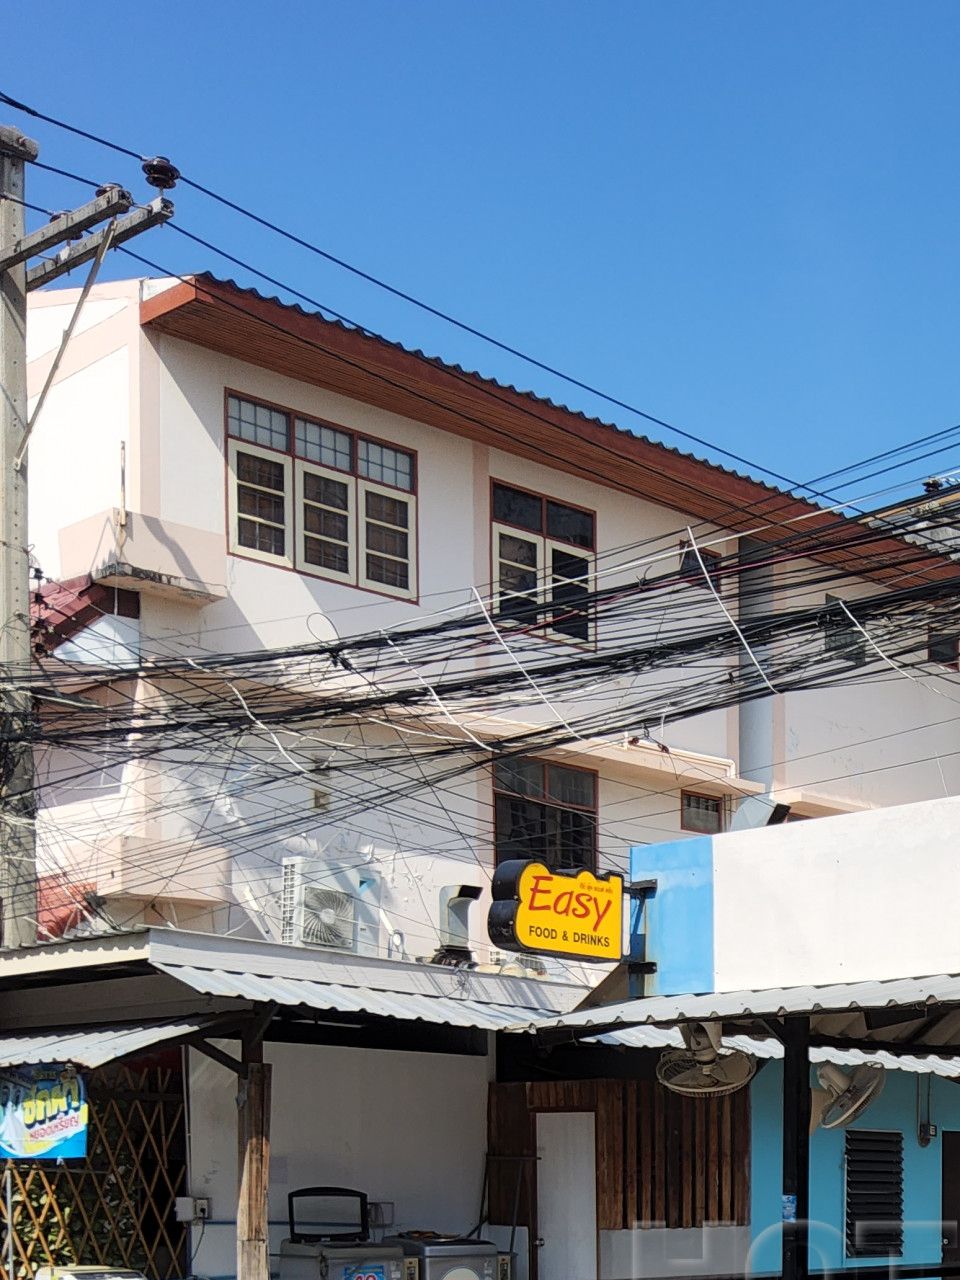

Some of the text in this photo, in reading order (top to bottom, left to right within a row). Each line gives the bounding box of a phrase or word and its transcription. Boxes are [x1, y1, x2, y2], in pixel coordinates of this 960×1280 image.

[528, 875, 613, 932] Easy
[528, 924, 611, 948] FOOD & DRINKS
